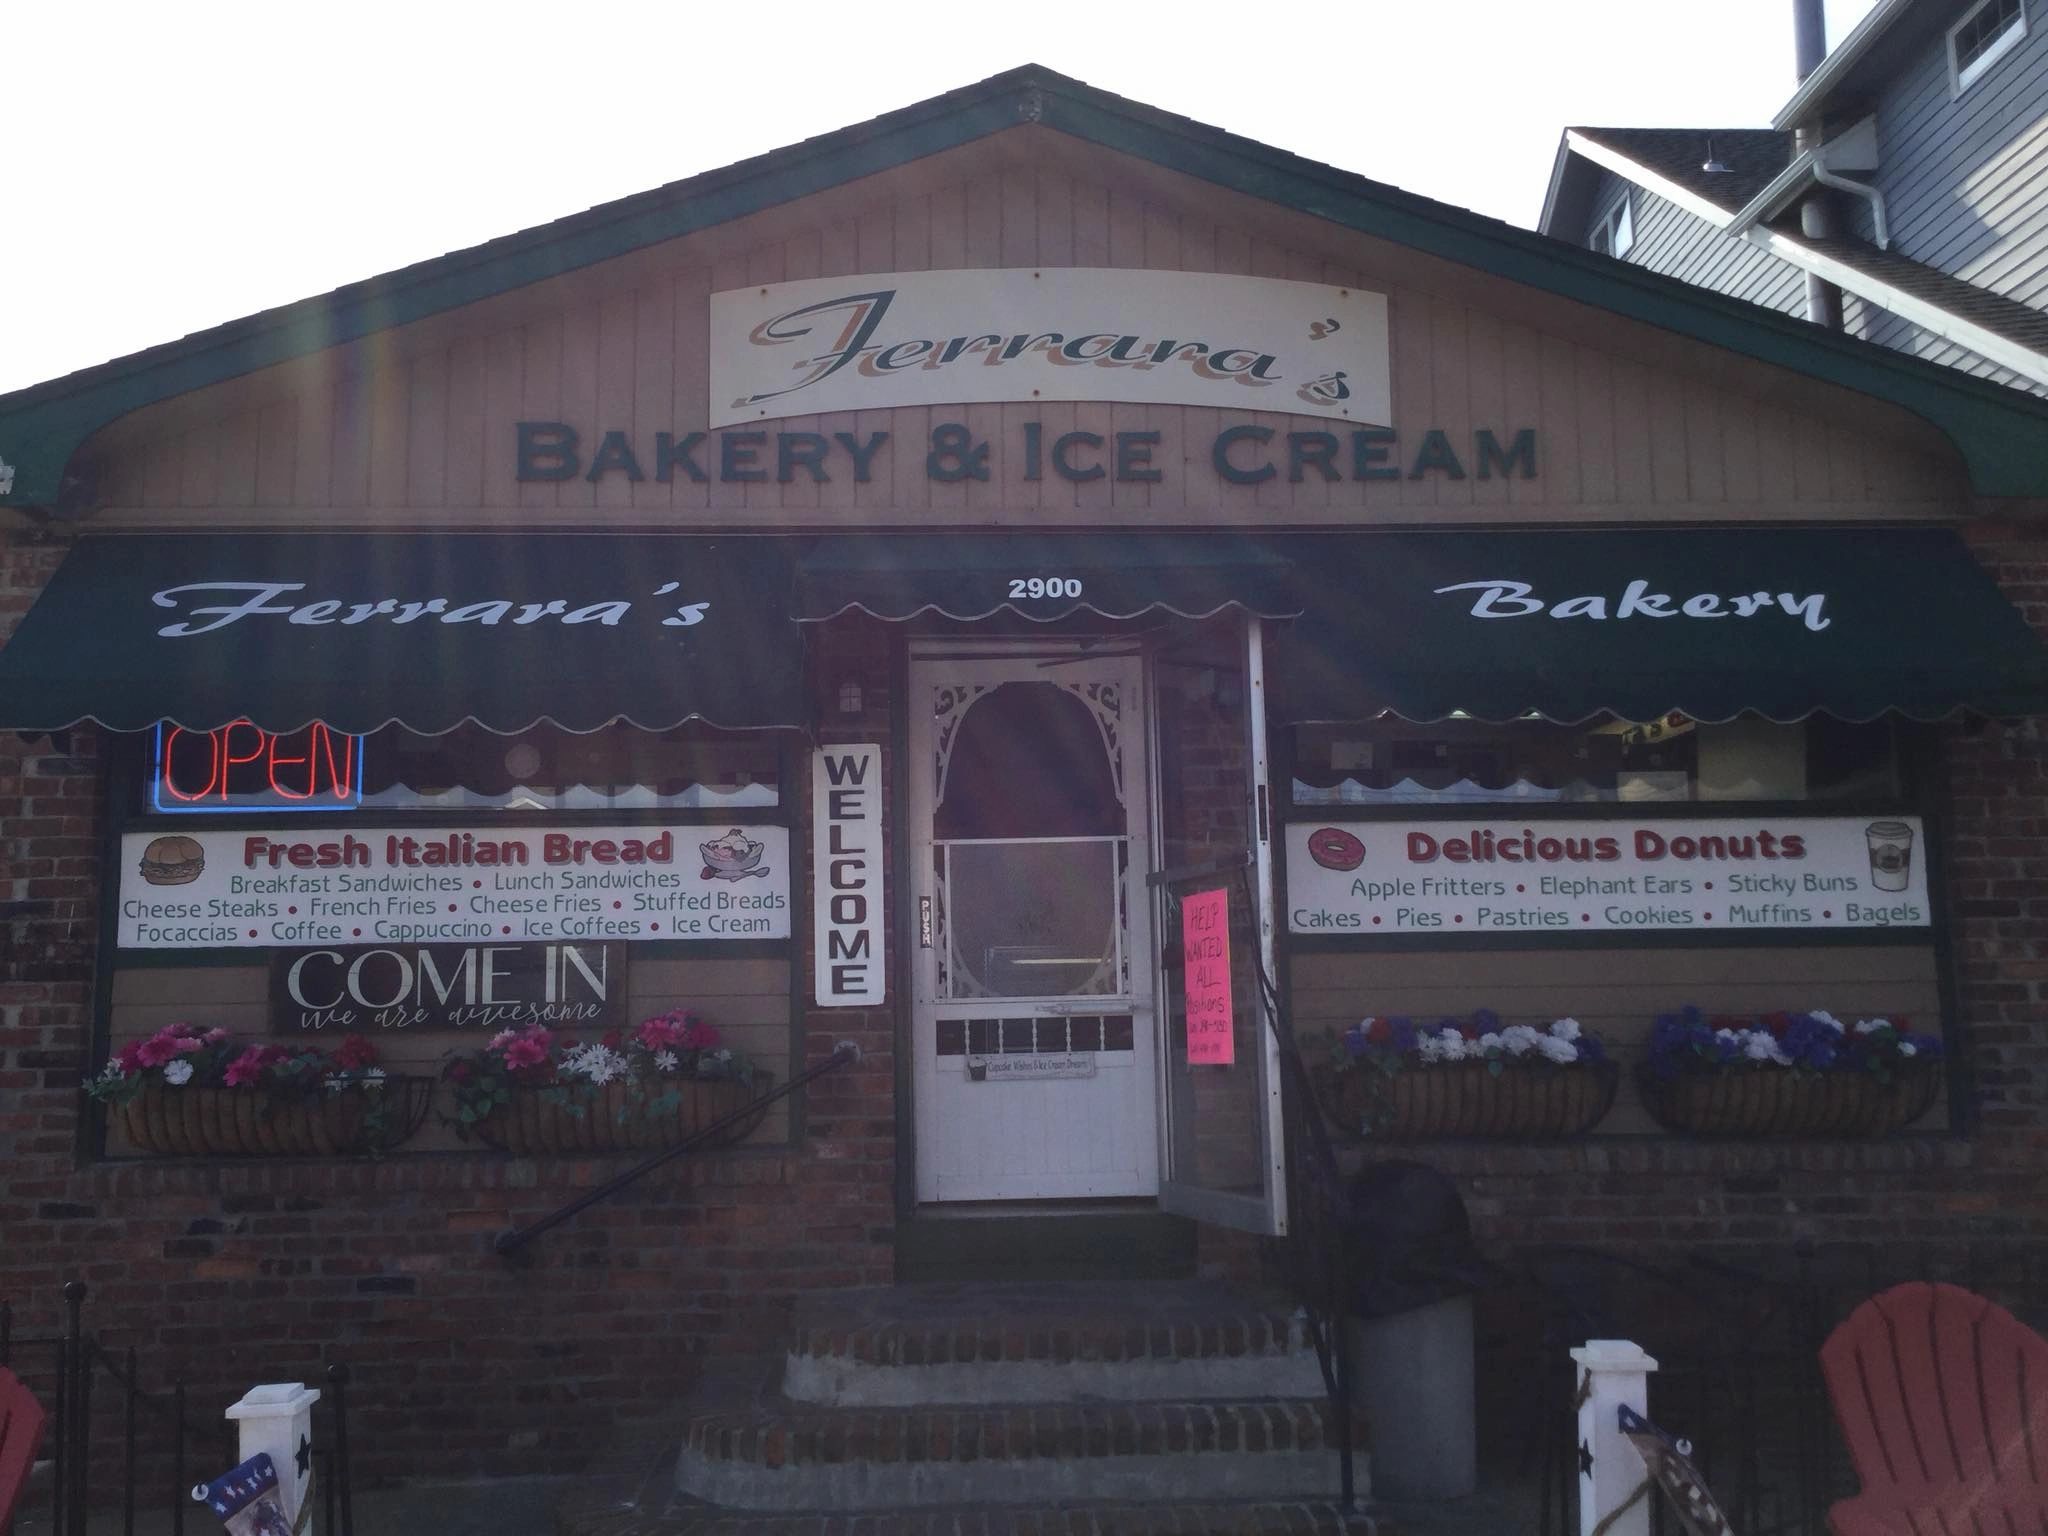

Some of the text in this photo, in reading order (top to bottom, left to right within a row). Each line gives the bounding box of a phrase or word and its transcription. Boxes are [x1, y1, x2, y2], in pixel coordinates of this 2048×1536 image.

[735, 290, 1350, 405] Ferrara's
[516, 422, 1538, 484] BAKERY & ICE CREAM
[1009, 578, 1082, 599] 2900
[1434, 580, 1830, 631] Bakery
[152, 582, 710, 637] Ferrara's
[166, 719, 352, 800] OPEN
[245, 831, 673, 869] Fresh Italian Bread
[1407, 829, 1806, 863] Delicious Donuts
[231, 870, 680, 893] Breakfast Sandwiches Lunch Sandwiches
[824, 755, 869, 994] WELCOME
[1351, 873, 1858, 901] Apple Fritters Elephant Ears Sticky Buns
[123, 891, 785, 918] Cheese Steaks French Fries Cheese Fries Stuffed Breads
[922, 900, 931, 945] PUSH
[1191, 902, 1218, 931] HELP
[1293, 904, 1921, 928] Cakes Pies Pastries Cookies Muffins Bagels
[137, 915, 770, 943] Focaccias Coffee Cappuccino Ice Coffees Ice Cream
[287, 945, 607, 1008] COME IN
[301, 1001, 601, 1028] we are awesome
